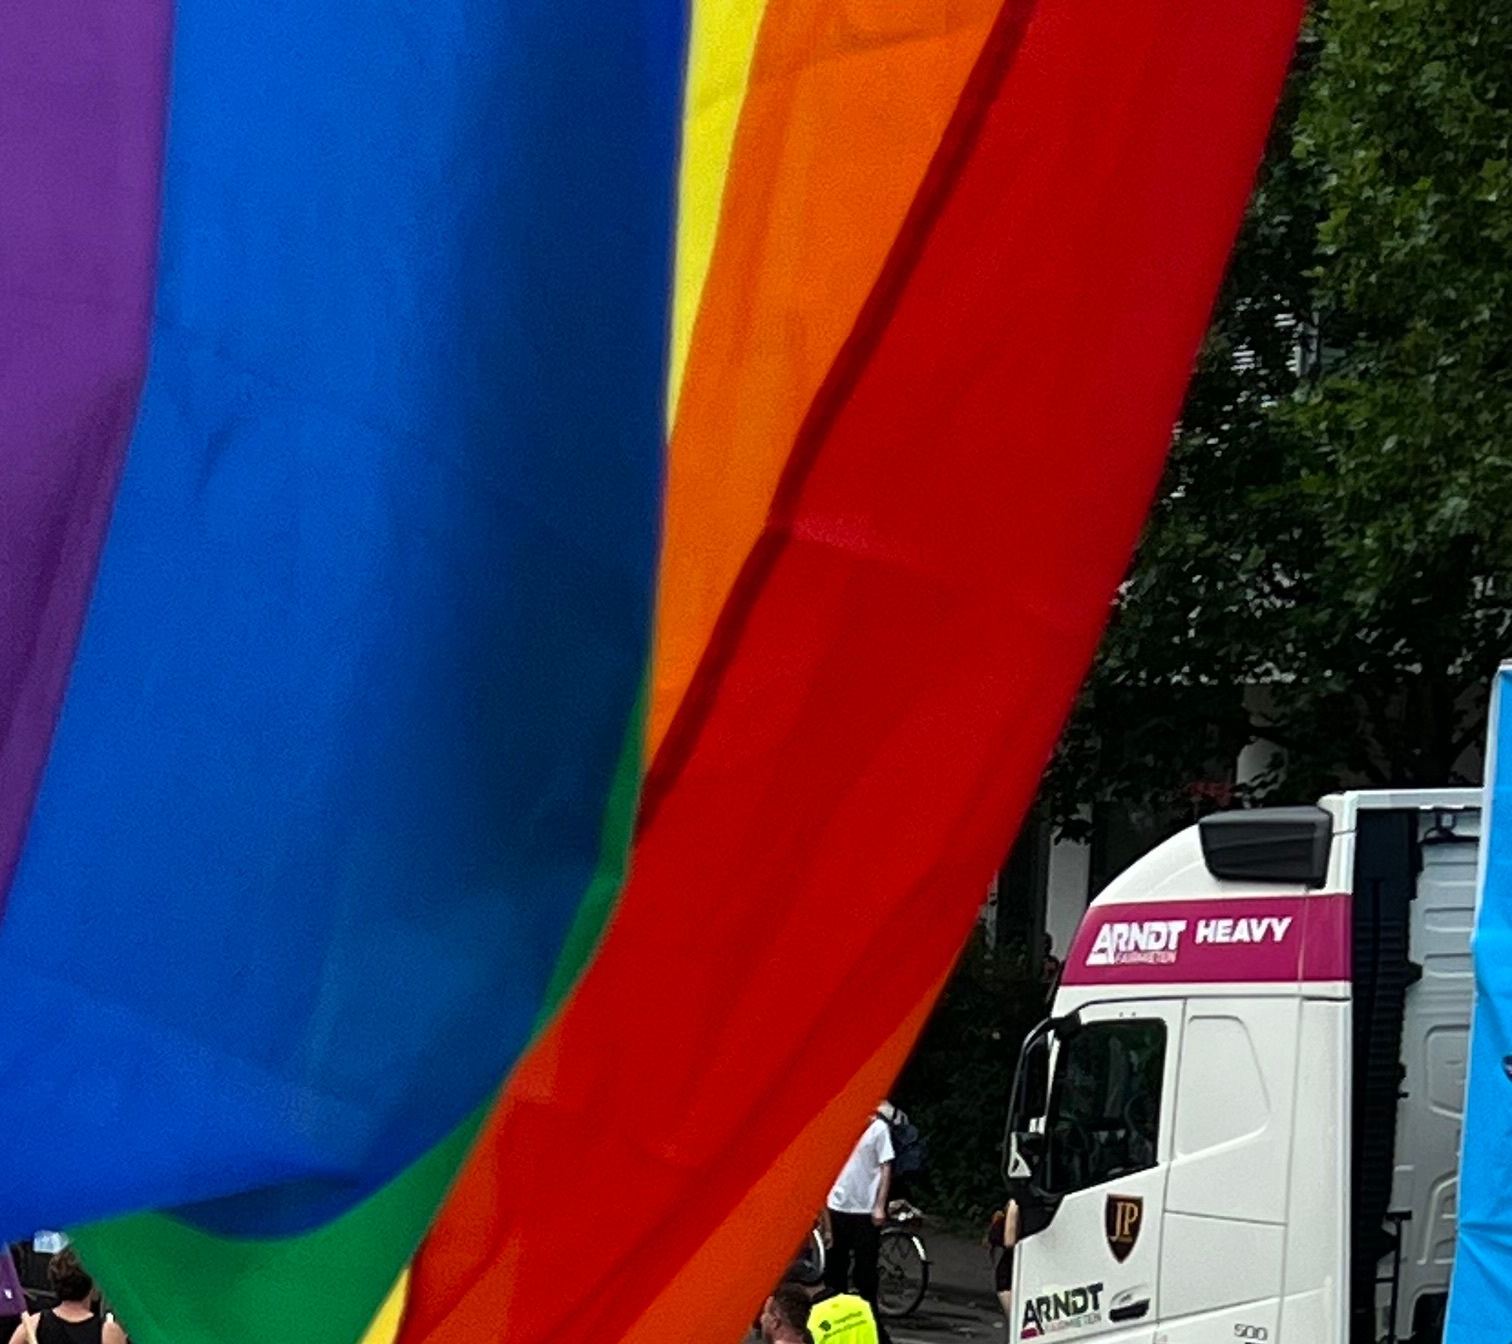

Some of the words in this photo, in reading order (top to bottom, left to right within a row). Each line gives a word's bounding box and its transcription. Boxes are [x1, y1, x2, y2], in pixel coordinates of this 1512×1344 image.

[1085, 920, 1188, 966] ARNDT
[1195, 916, 1292, 945] HEAVY
[1109, 1201, 1139, 1242] JP
[1020, 1282, 1104, 1340] ARNDT
[1234, 1323, 1268, 1341] 500
